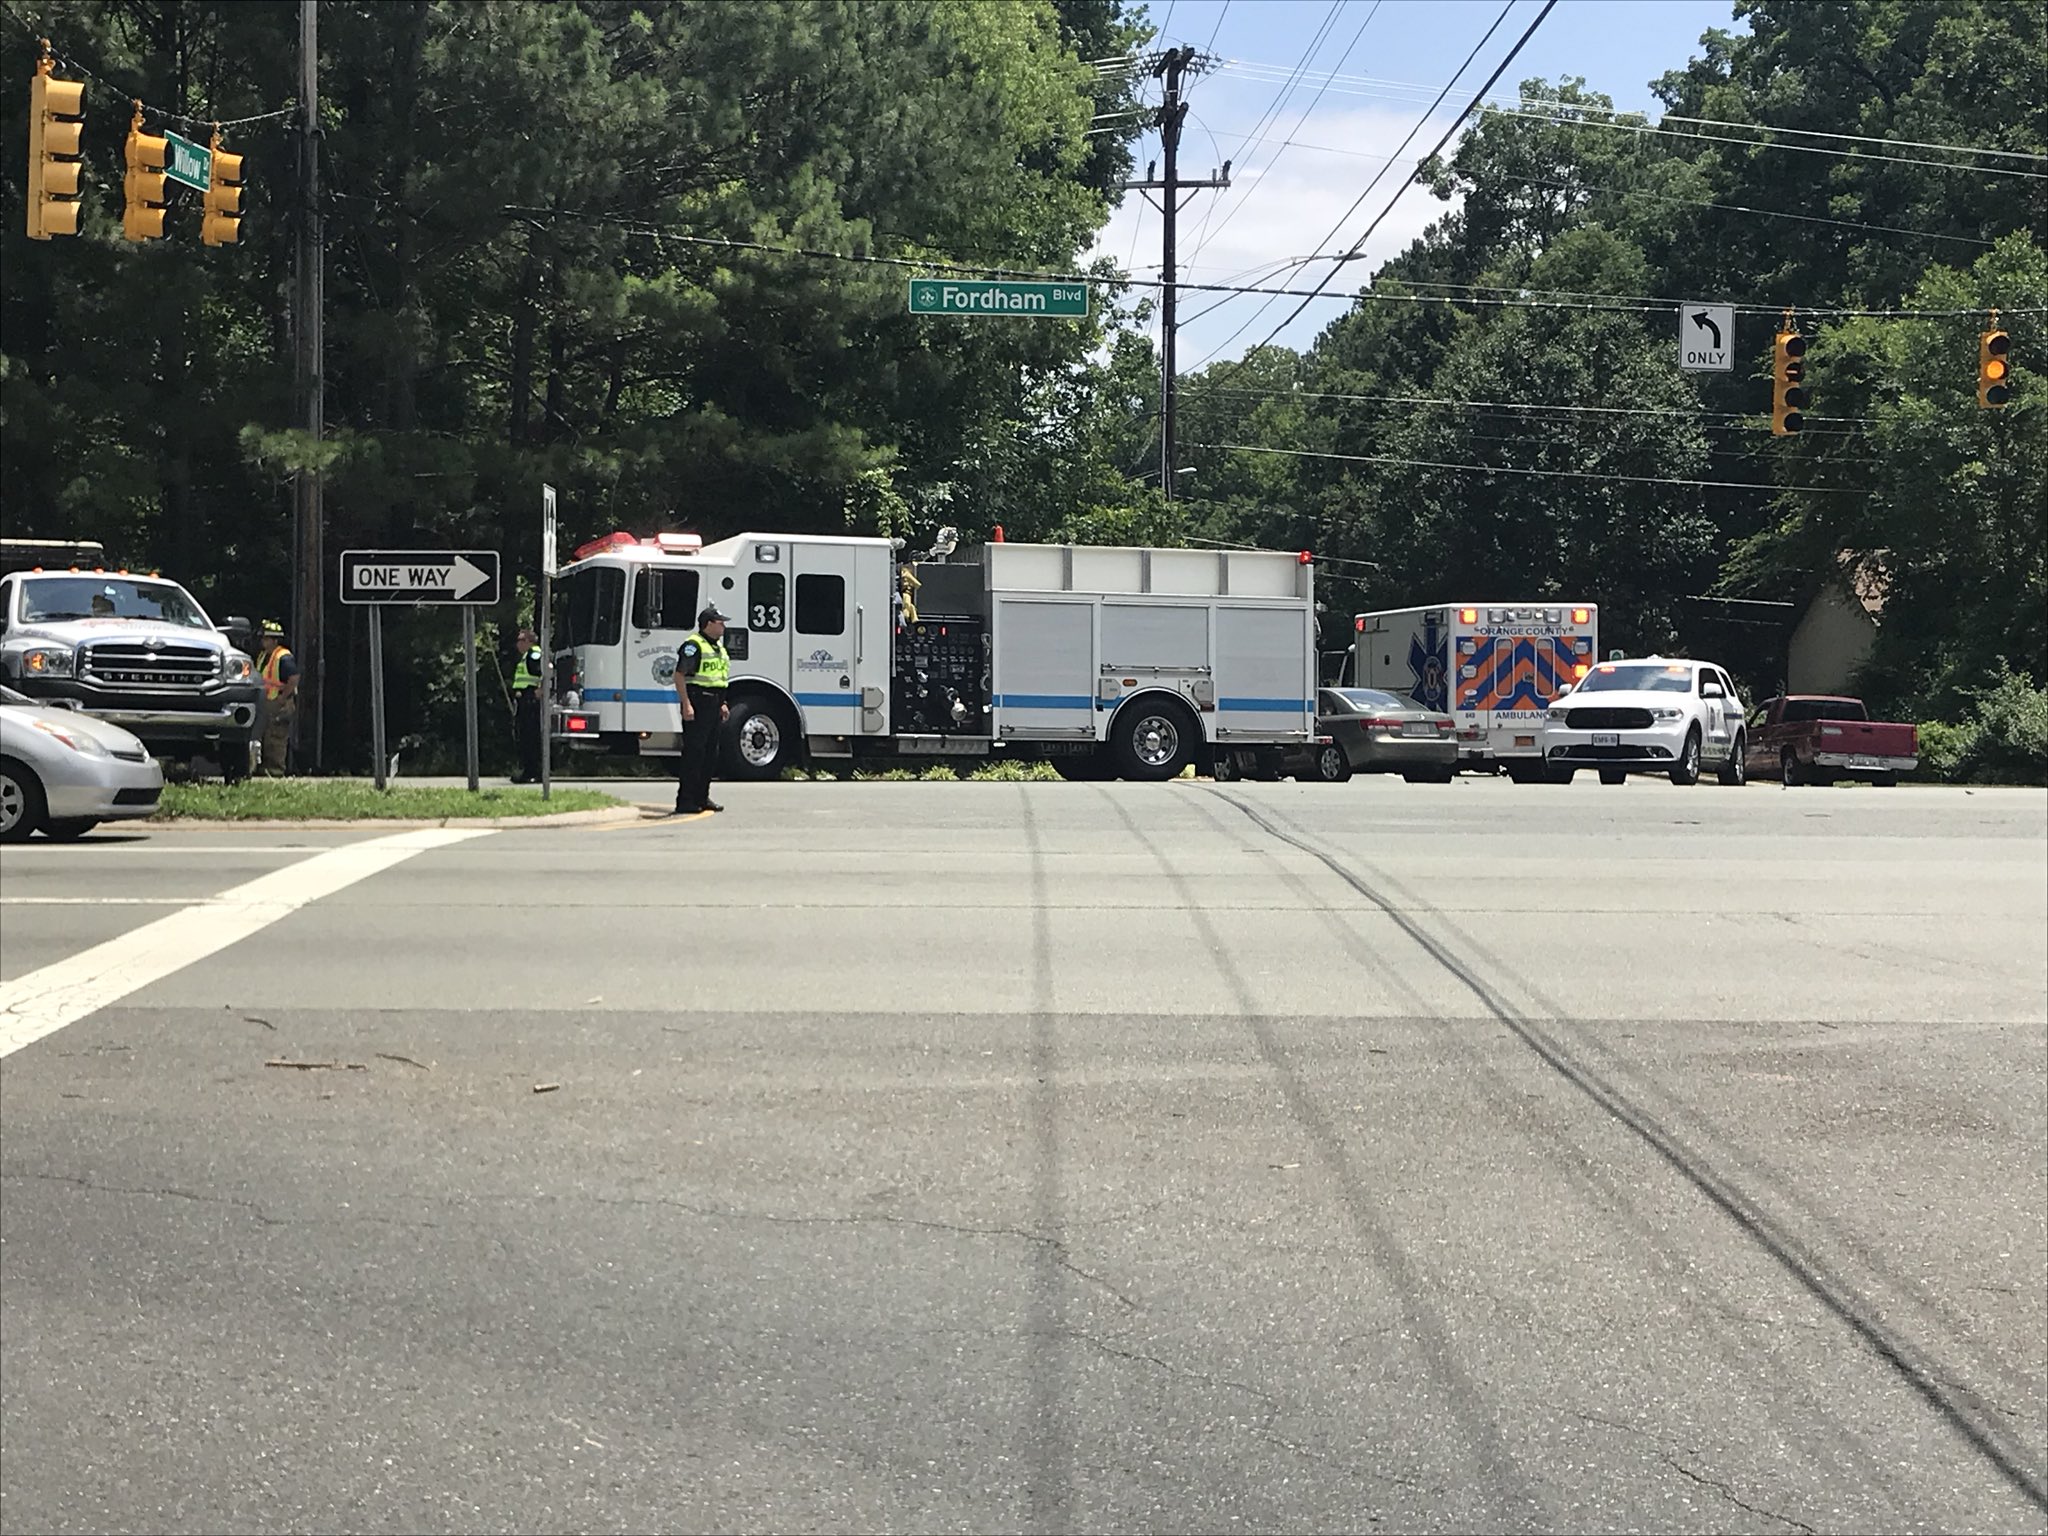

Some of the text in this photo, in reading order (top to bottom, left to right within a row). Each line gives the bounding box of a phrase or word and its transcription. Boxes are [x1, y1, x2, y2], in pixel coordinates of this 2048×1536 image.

[174, 143, 202, 180] Willow
[943, 286, 1081, 310] Fordham Blvd
[1687, 351, 1725, 364] ONLY
[359, 568, 451, 586] ONE WAY
[752, 604, 781, 628] 33
[1479, 627, 1568, 636] ORANGE COUNTY
[103, 672, 203, 682] STERLING
